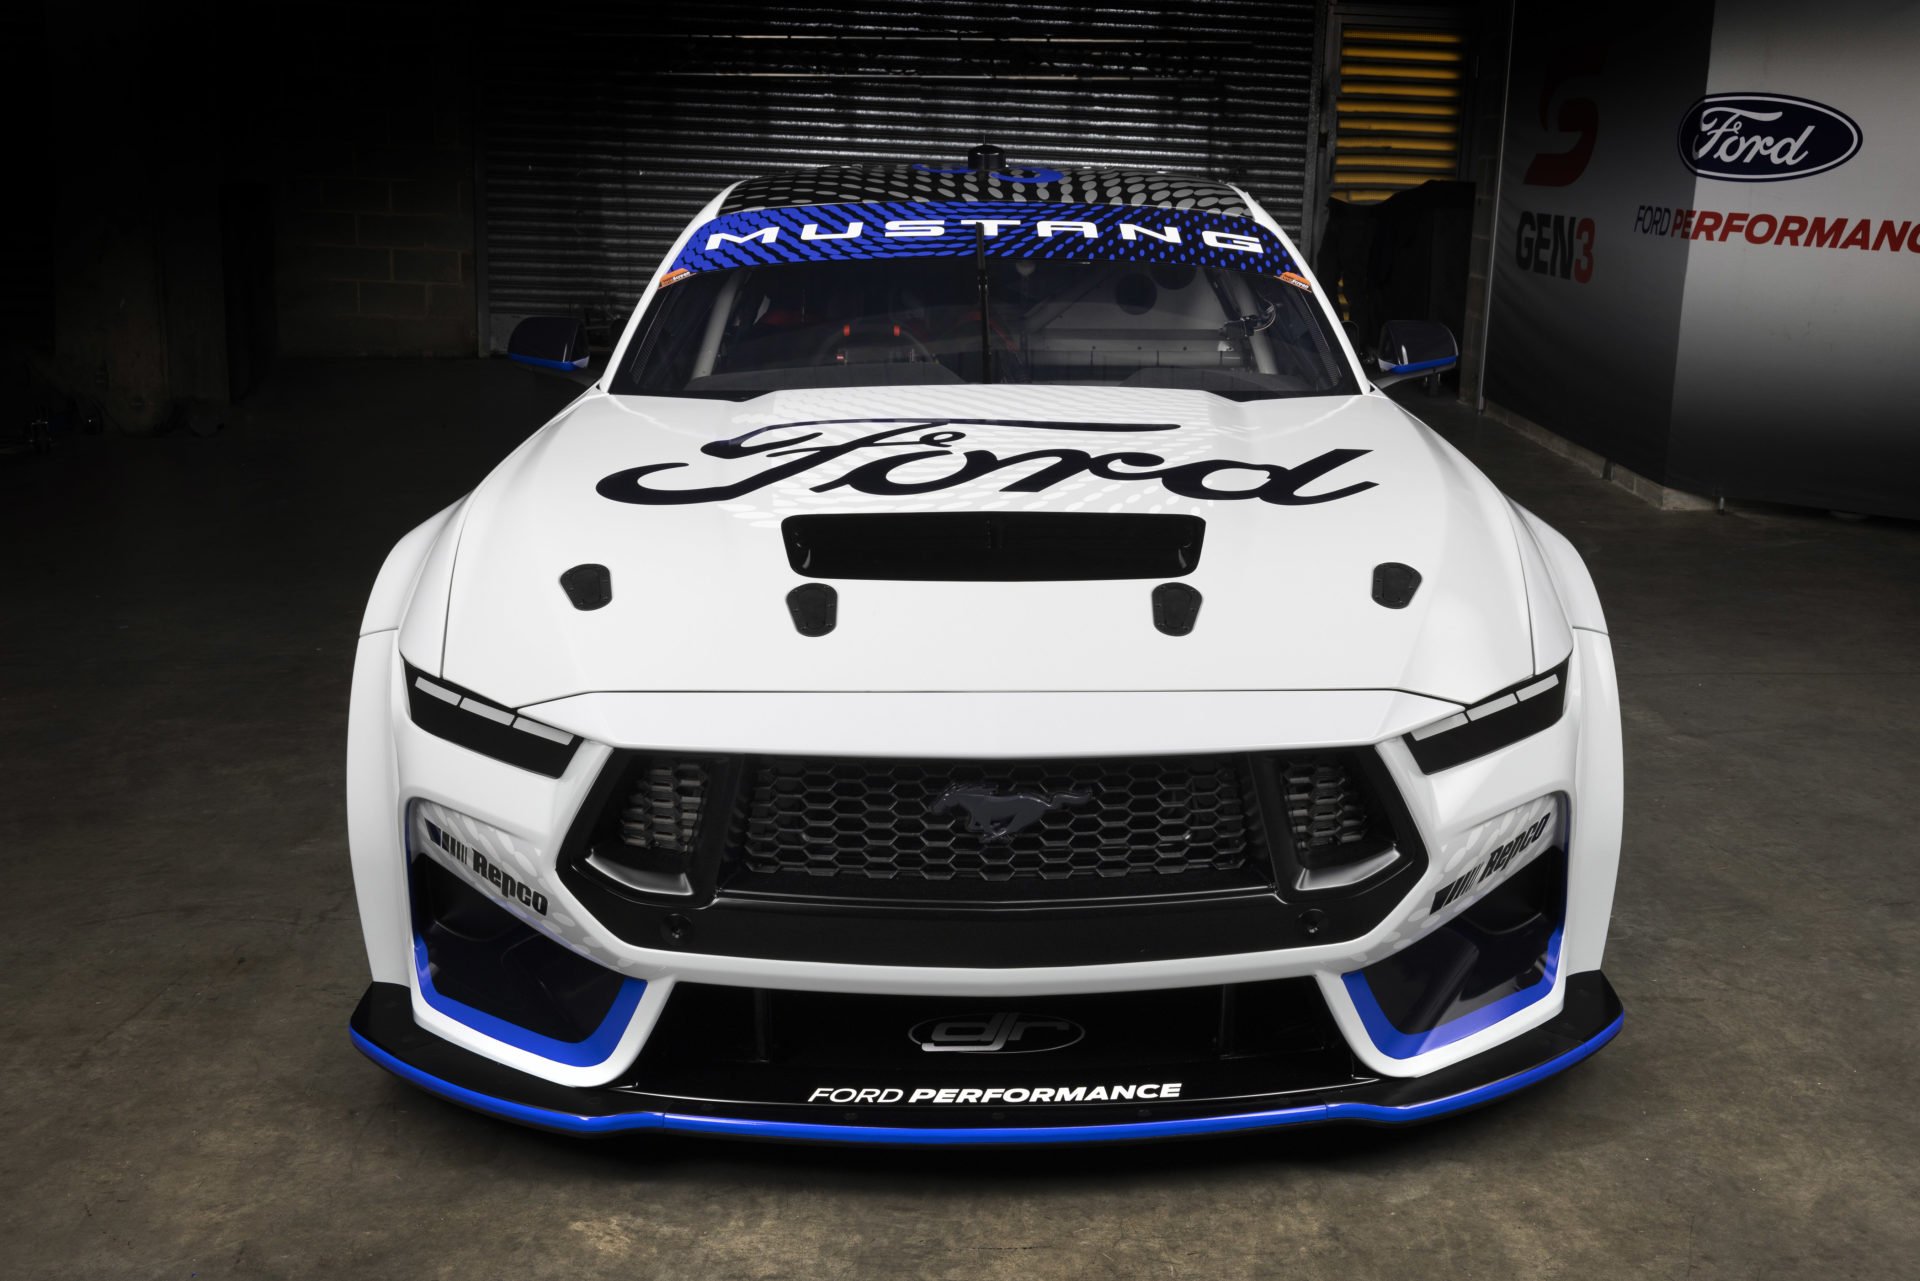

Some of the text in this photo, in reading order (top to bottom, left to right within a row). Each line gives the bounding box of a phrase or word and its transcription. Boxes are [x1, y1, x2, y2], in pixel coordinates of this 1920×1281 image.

[1692, 107, 1815, 166] Ford
[705, 219, 1264, 254] MUSTANG
[1516, 211, 1596, 284] GEN3
[1634, 205, 1671, 237] FORD
[596, 418, 1379, 506] Ford
[1477, 812, 1551, 884] Repco
[472, 848, 549, 916] Repco
[807, 1083, 1182, 1103] FORD PERFORMANCE
